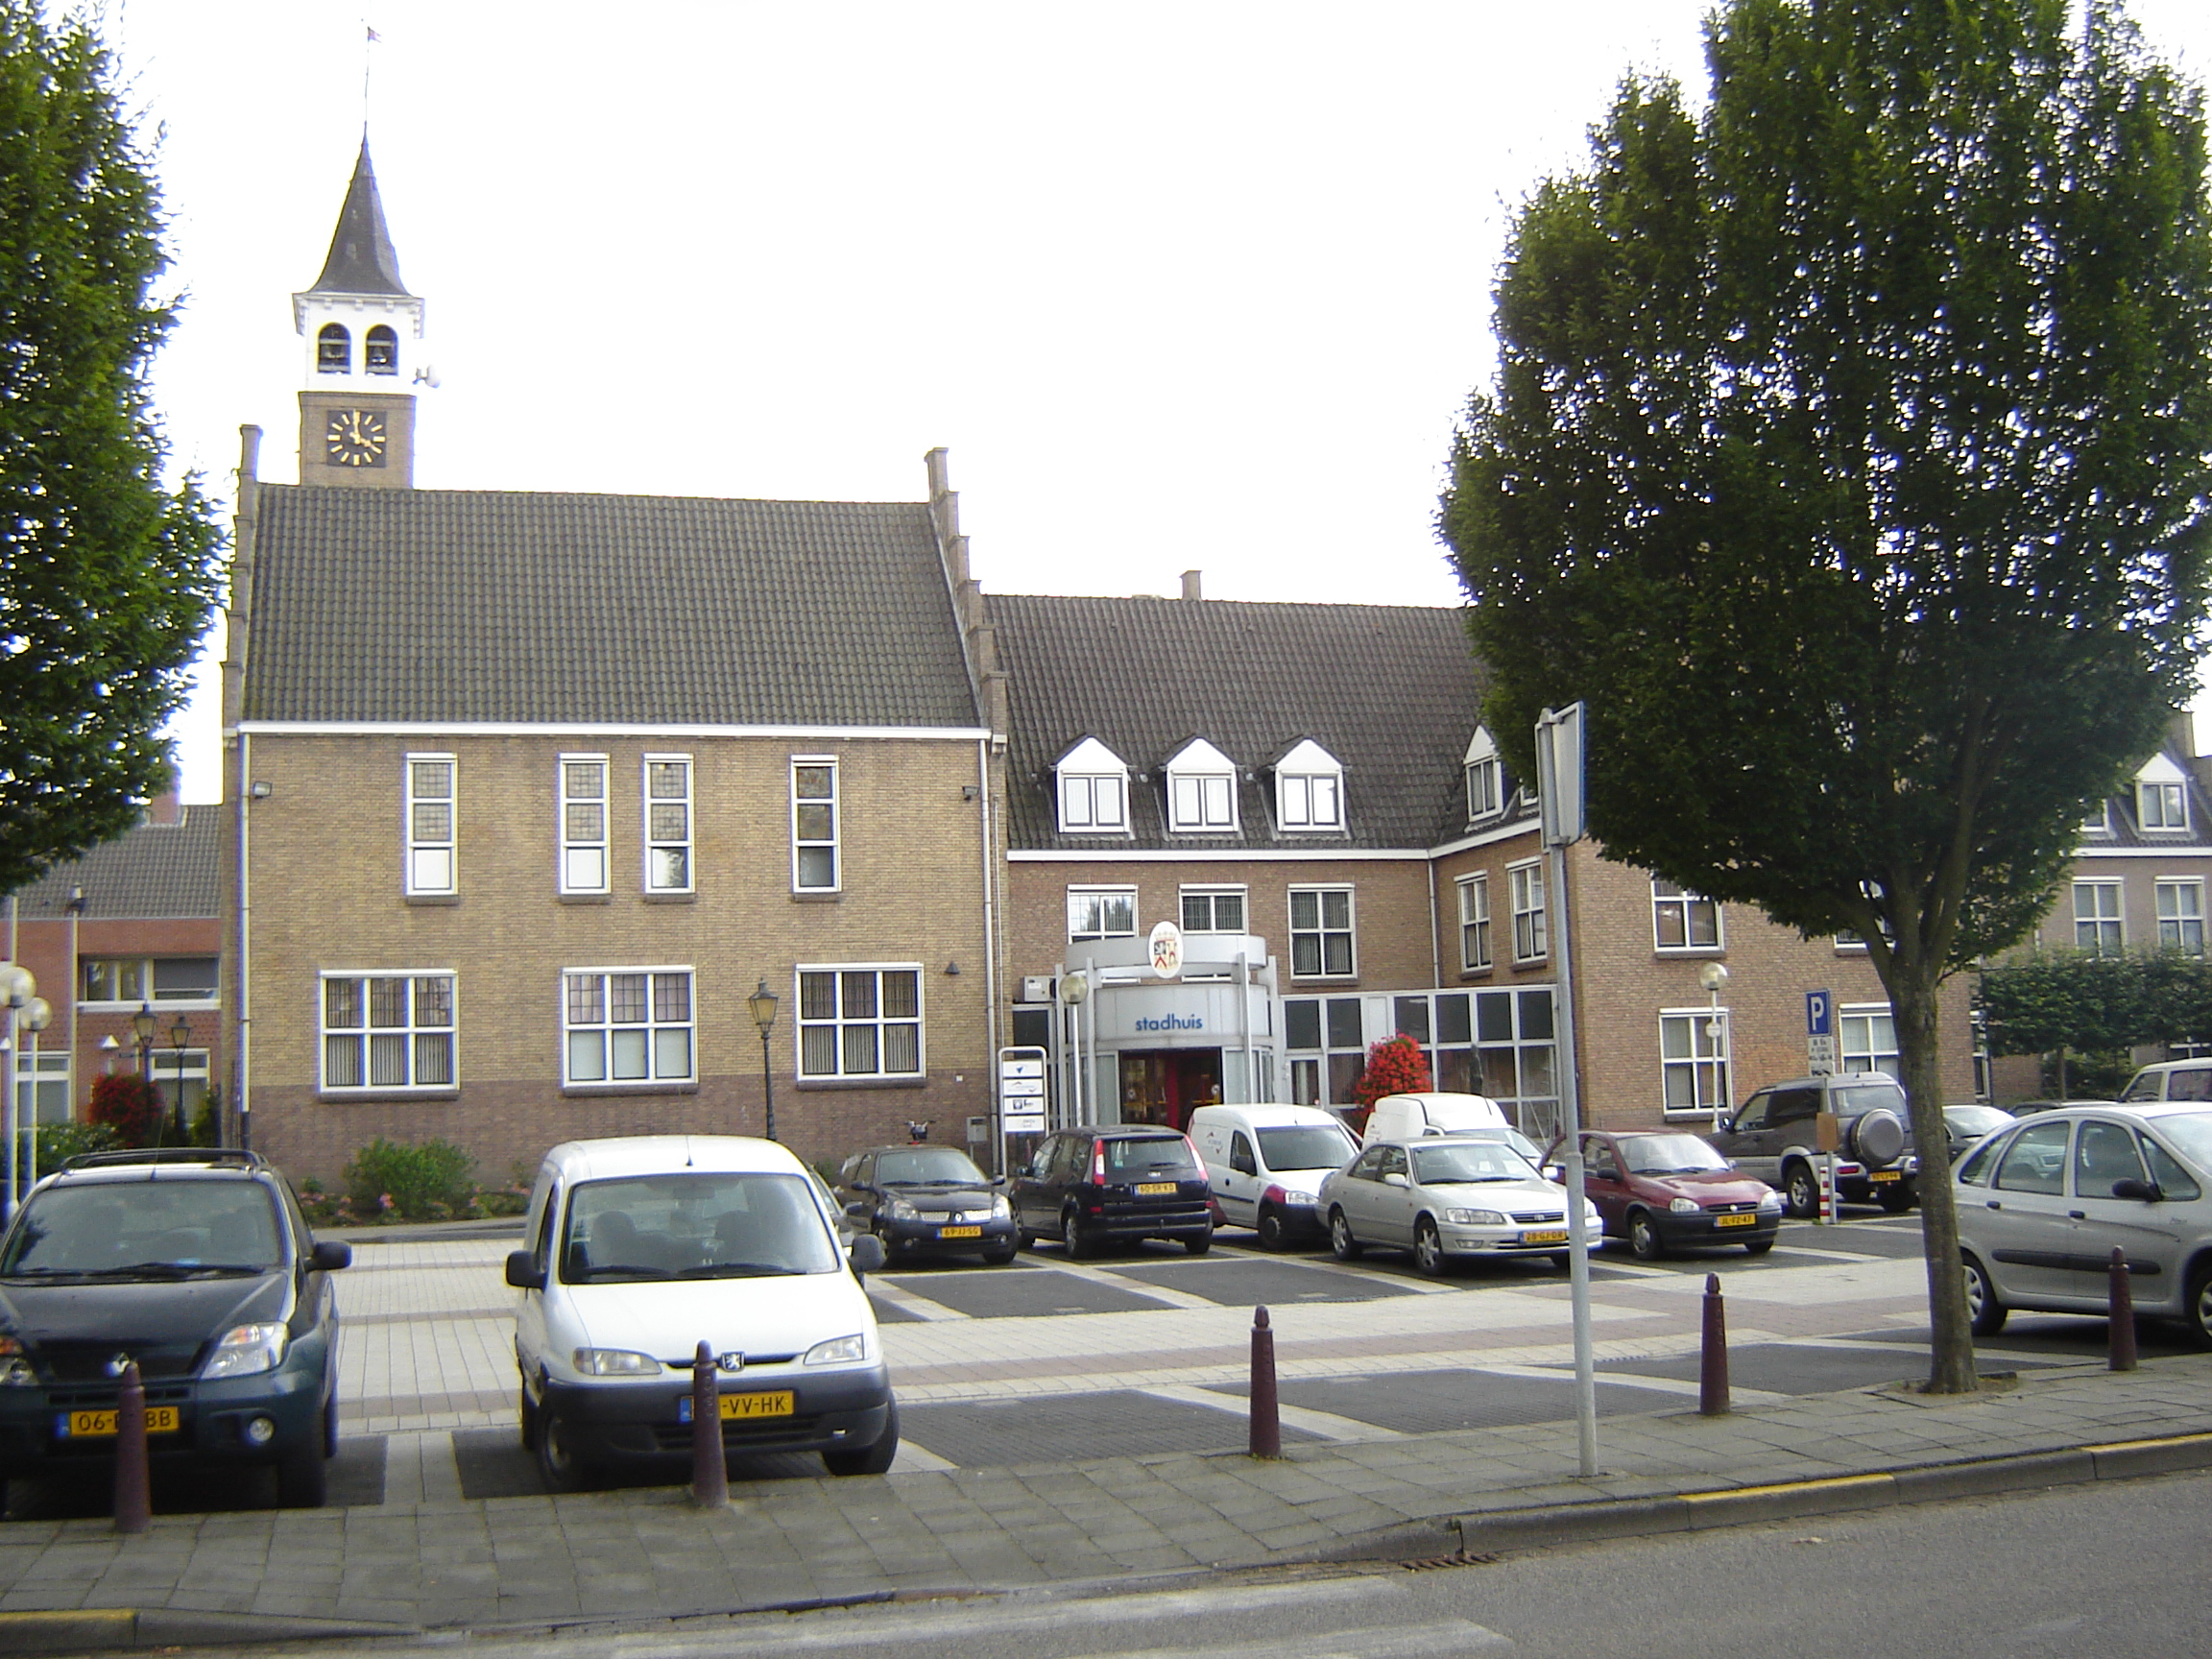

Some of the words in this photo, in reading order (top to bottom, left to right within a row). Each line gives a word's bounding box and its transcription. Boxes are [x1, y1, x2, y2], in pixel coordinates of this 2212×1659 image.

[1135, 1013, 1203, 1031] stadhuis
[1810, 996, 1824, 1030] P
[945, 1226, 978, 1236] 69-JJ-SG
